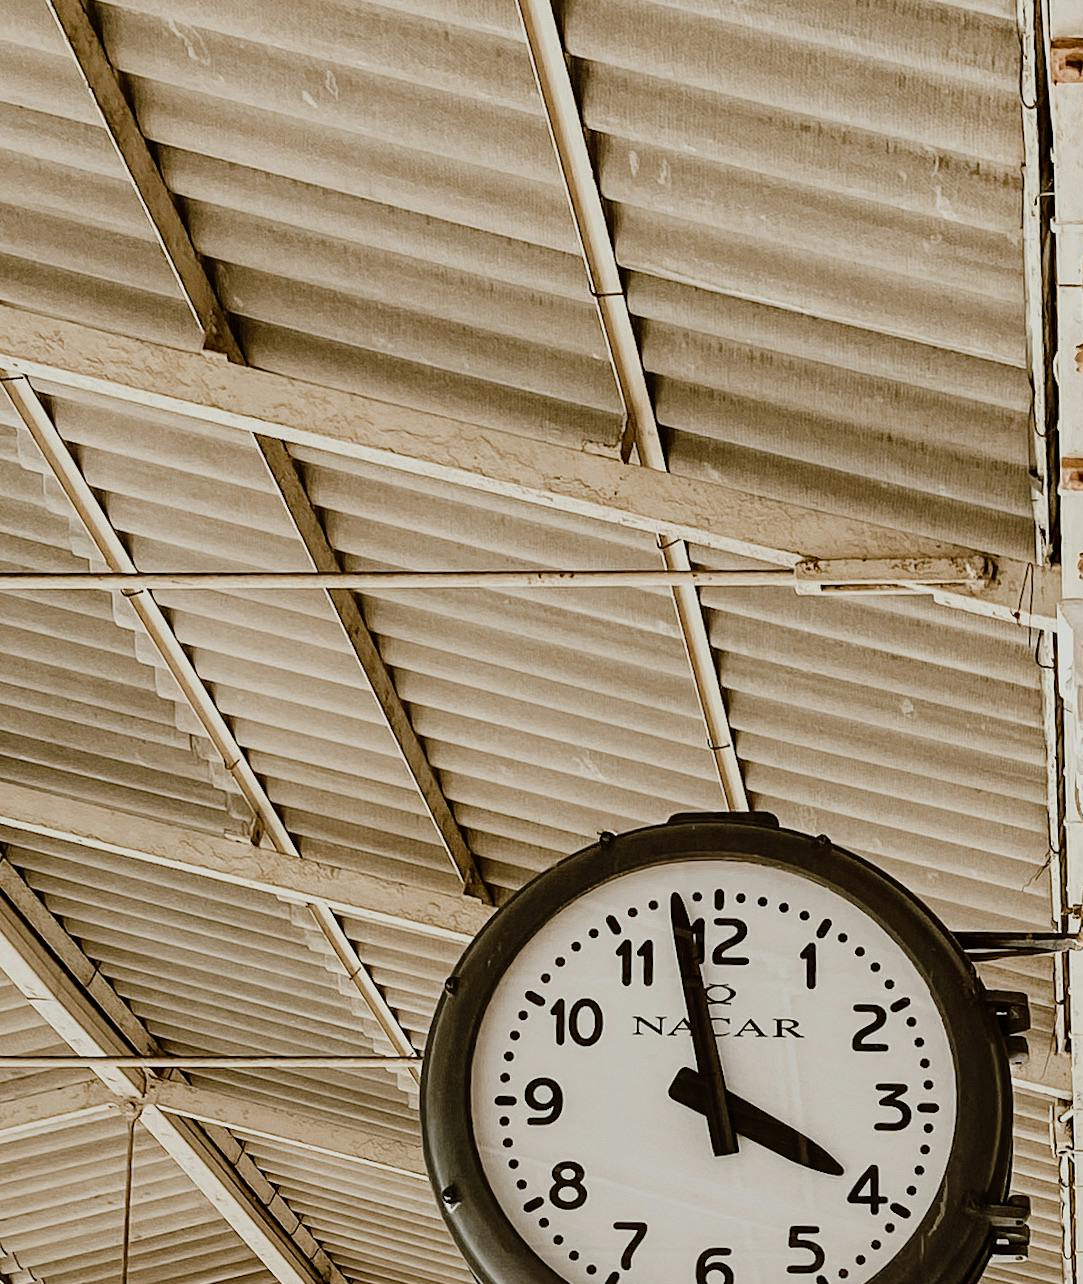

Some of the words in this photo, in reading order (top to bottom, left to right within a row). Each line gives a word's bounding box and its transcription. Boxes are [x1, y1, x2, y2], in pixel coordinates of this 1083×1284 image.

[615, 938, 654, 987] 11
[689, 917, 750, 966] 12
[799, 942, 817, 990] 1
[550, 998, 604, 1047] 10
[632, 1015, 805, 1039] NACAR
[851, 1003, 889, 1053] 2
[524, 1077, 564, 1126] 9
[873, 1083, 912, 1132] 3
[548, 1160, 588, 1211] 8
[846, 1164, 889, 1216] 4
[612, 1221, 648, 1271] 7
[786, 1225, 826, 1275] 5
